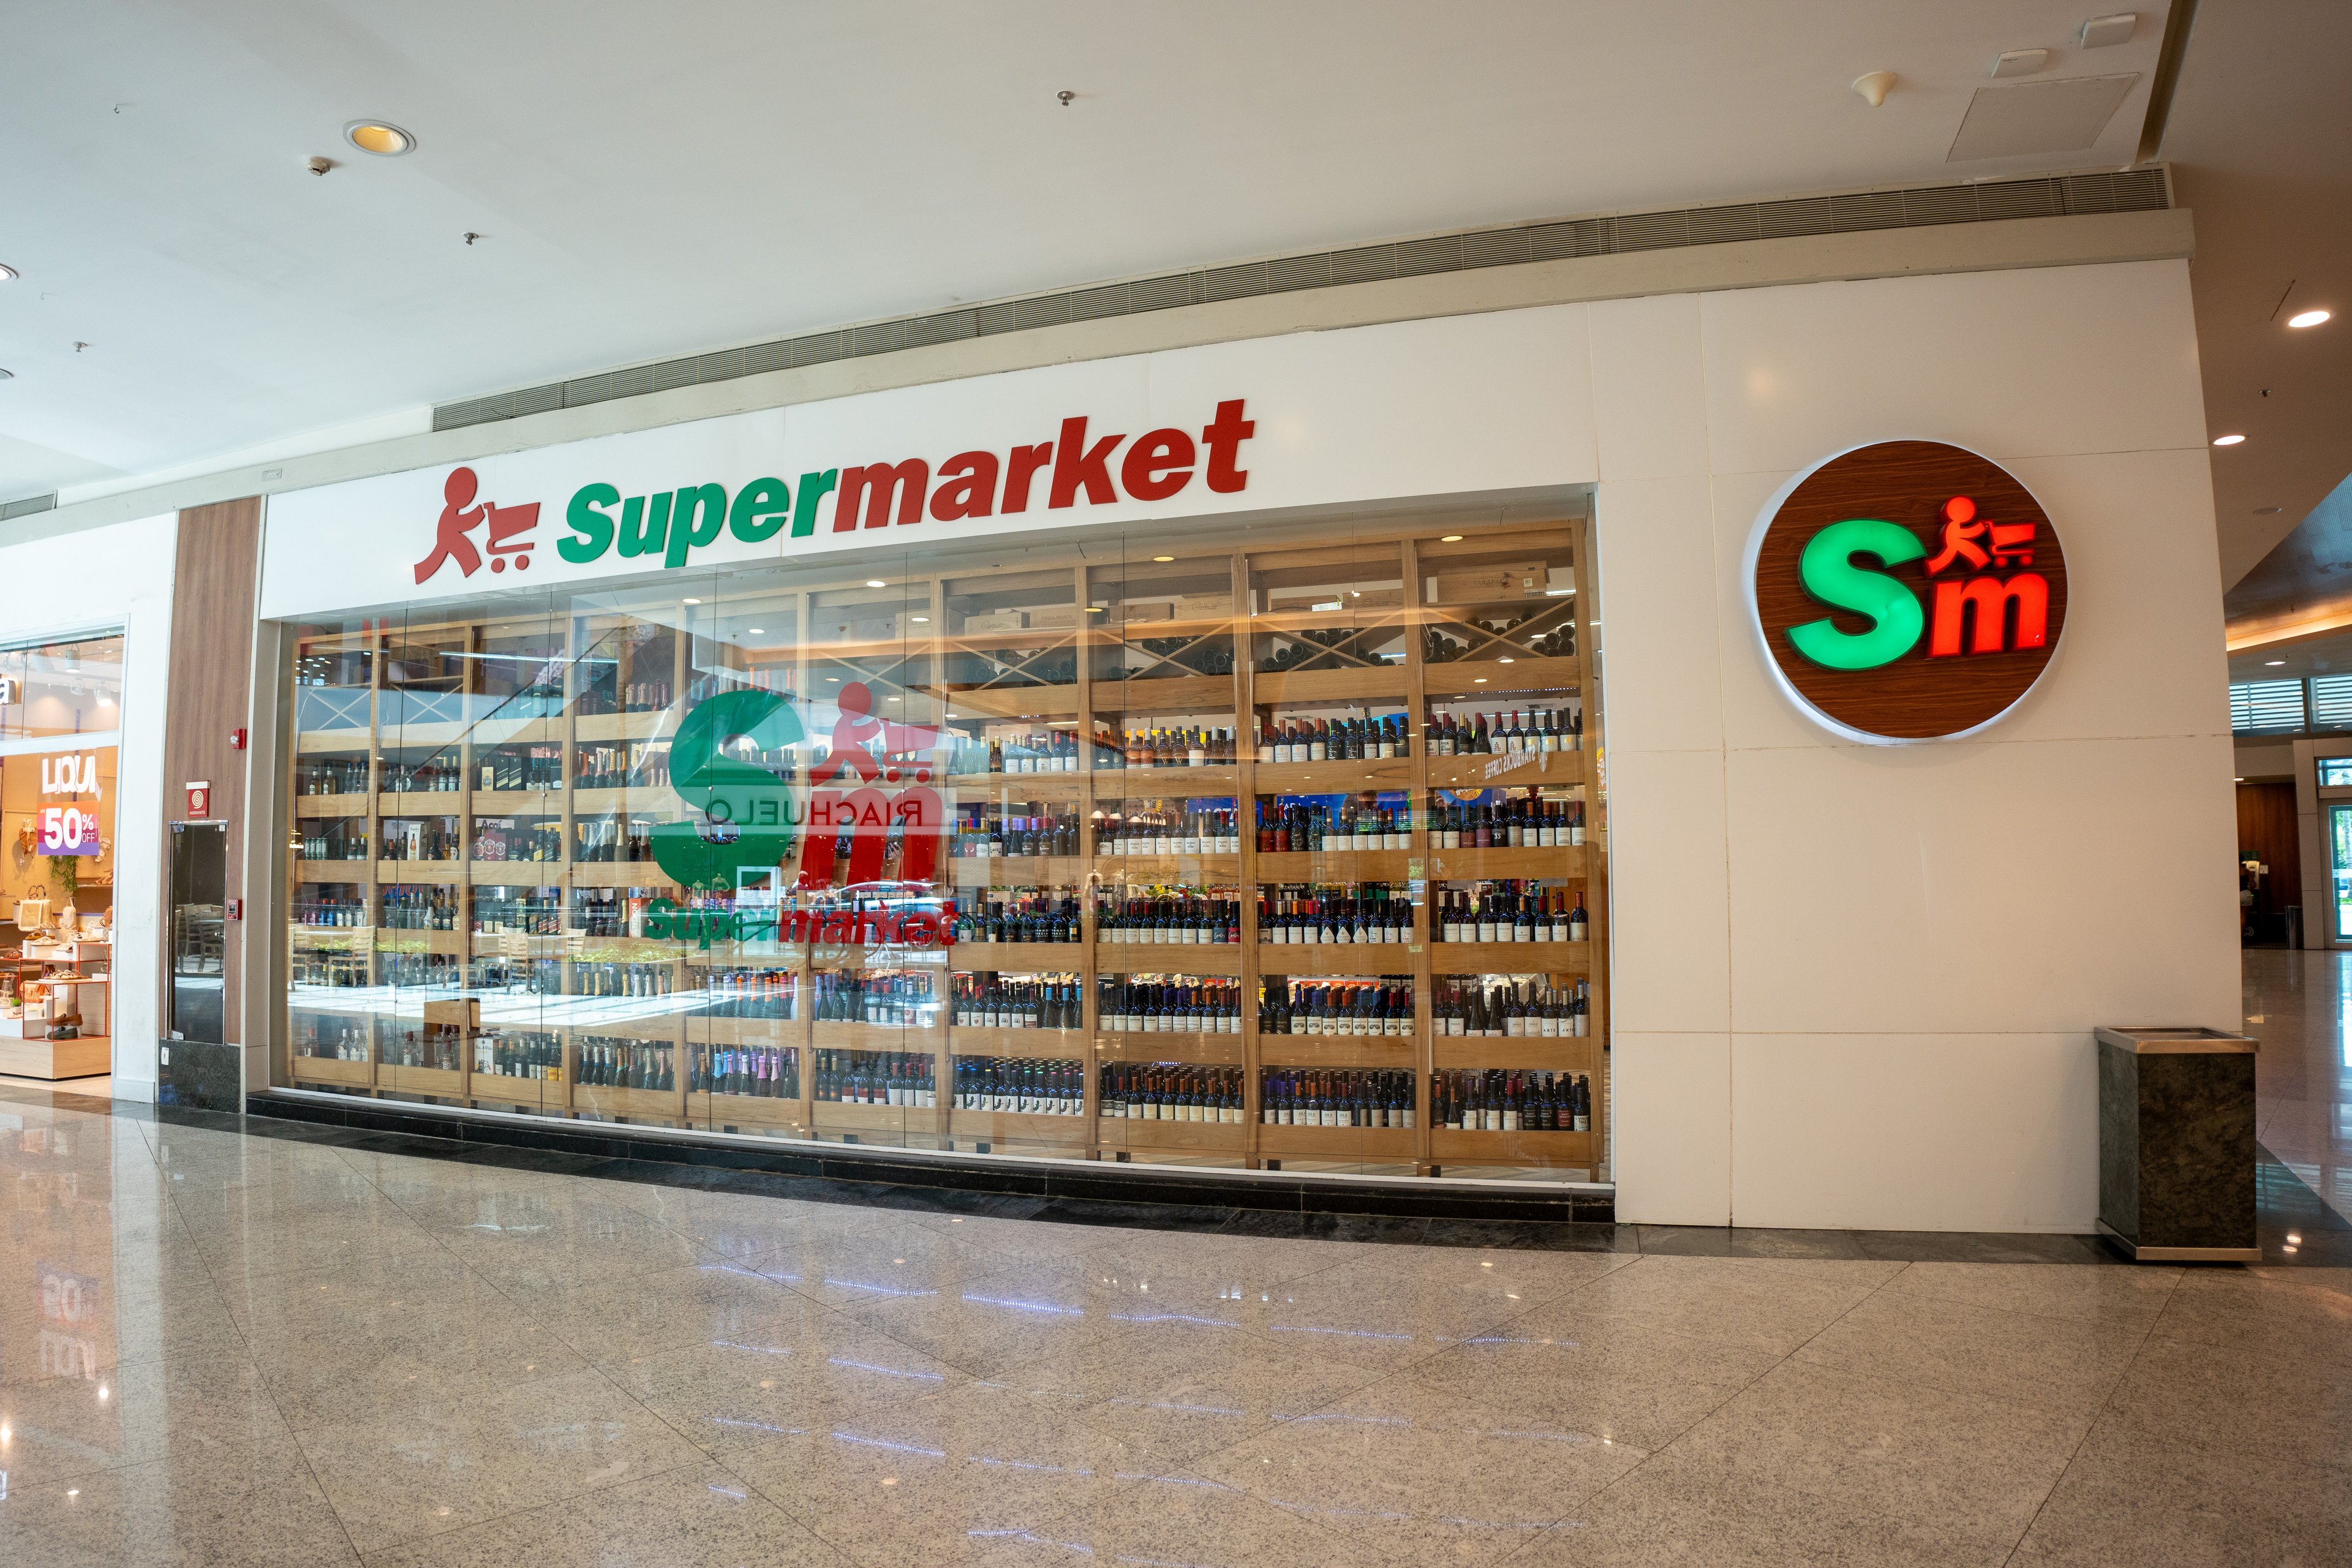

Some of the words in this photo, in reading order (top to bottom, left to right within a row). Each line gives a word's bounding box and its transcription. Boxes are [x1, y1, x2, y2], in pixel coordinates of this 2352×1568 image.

[557, 400, 1255, 568] Supermarket
[1783, 517, 2049, 672] Sm
[42, 755, 96, 795] LIQUI
[650, 689, 943, 891] Sm
[81, 832, 95, 843] OFF
[644, 897, 960, 950] Supermarket
